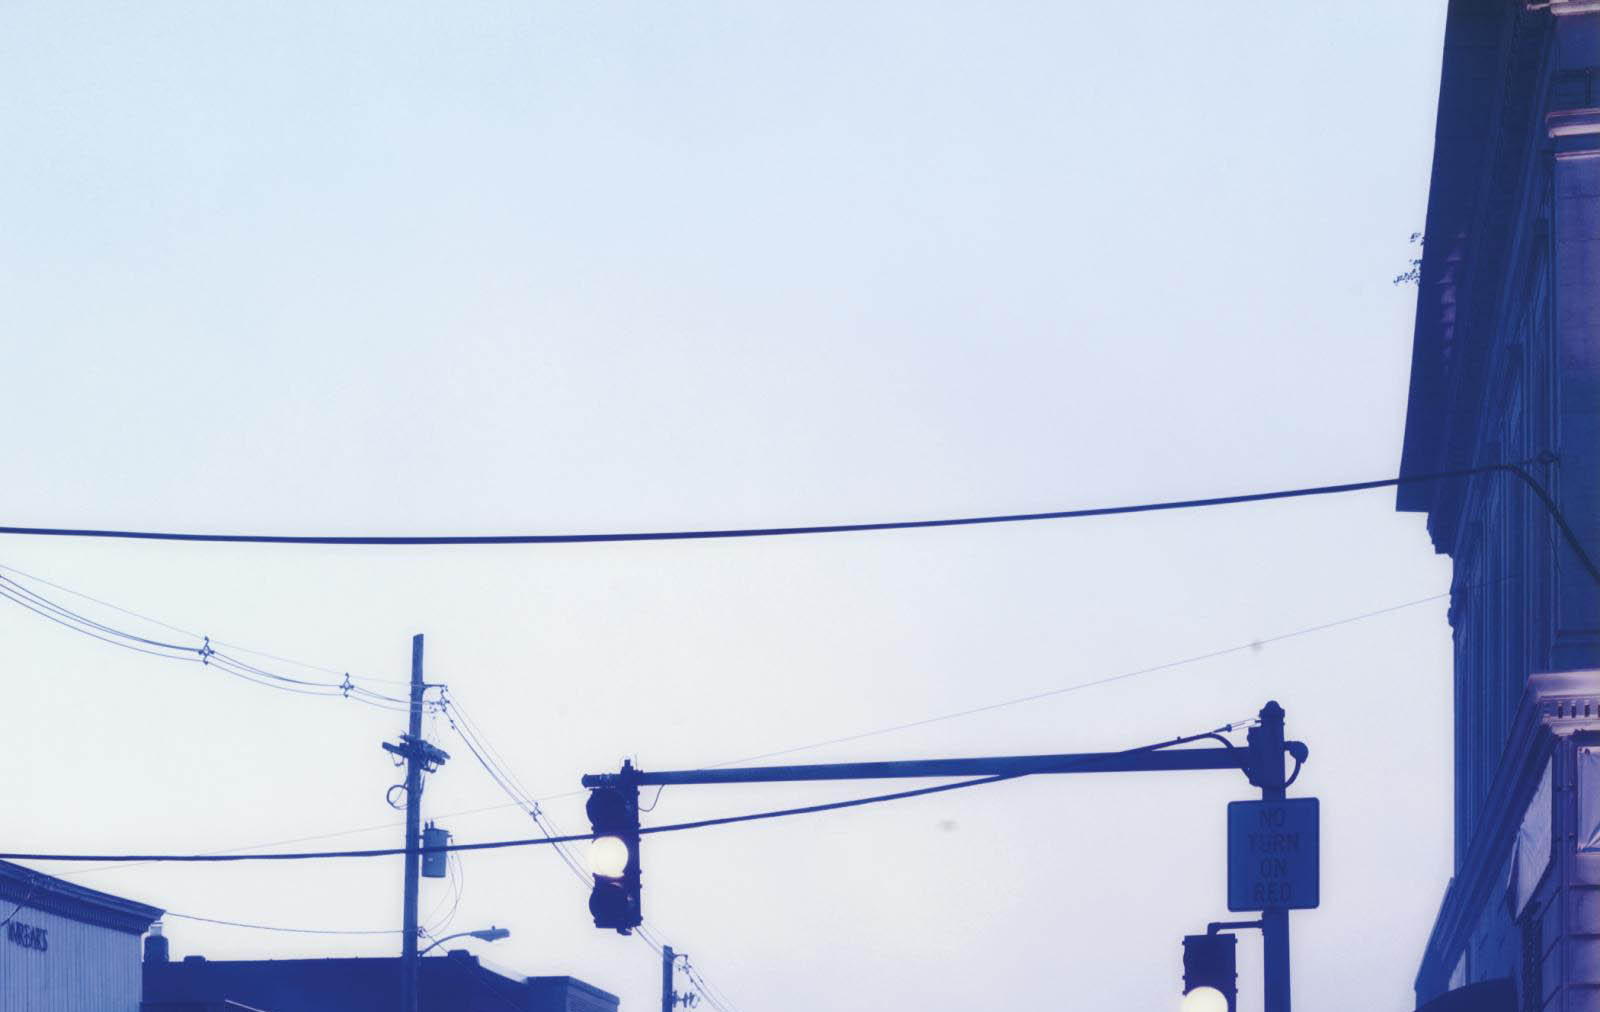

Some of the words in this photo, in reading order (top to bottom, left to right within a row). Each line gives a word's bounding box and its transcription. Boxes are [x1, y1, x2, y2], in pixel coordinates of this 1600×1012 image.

[1260, 808, 1285, 827] NO
[1248, 833, 1299, 852] TURN
[1260, 858, 1287, 877] ON
[1255, 882, 1292, 901] RED
